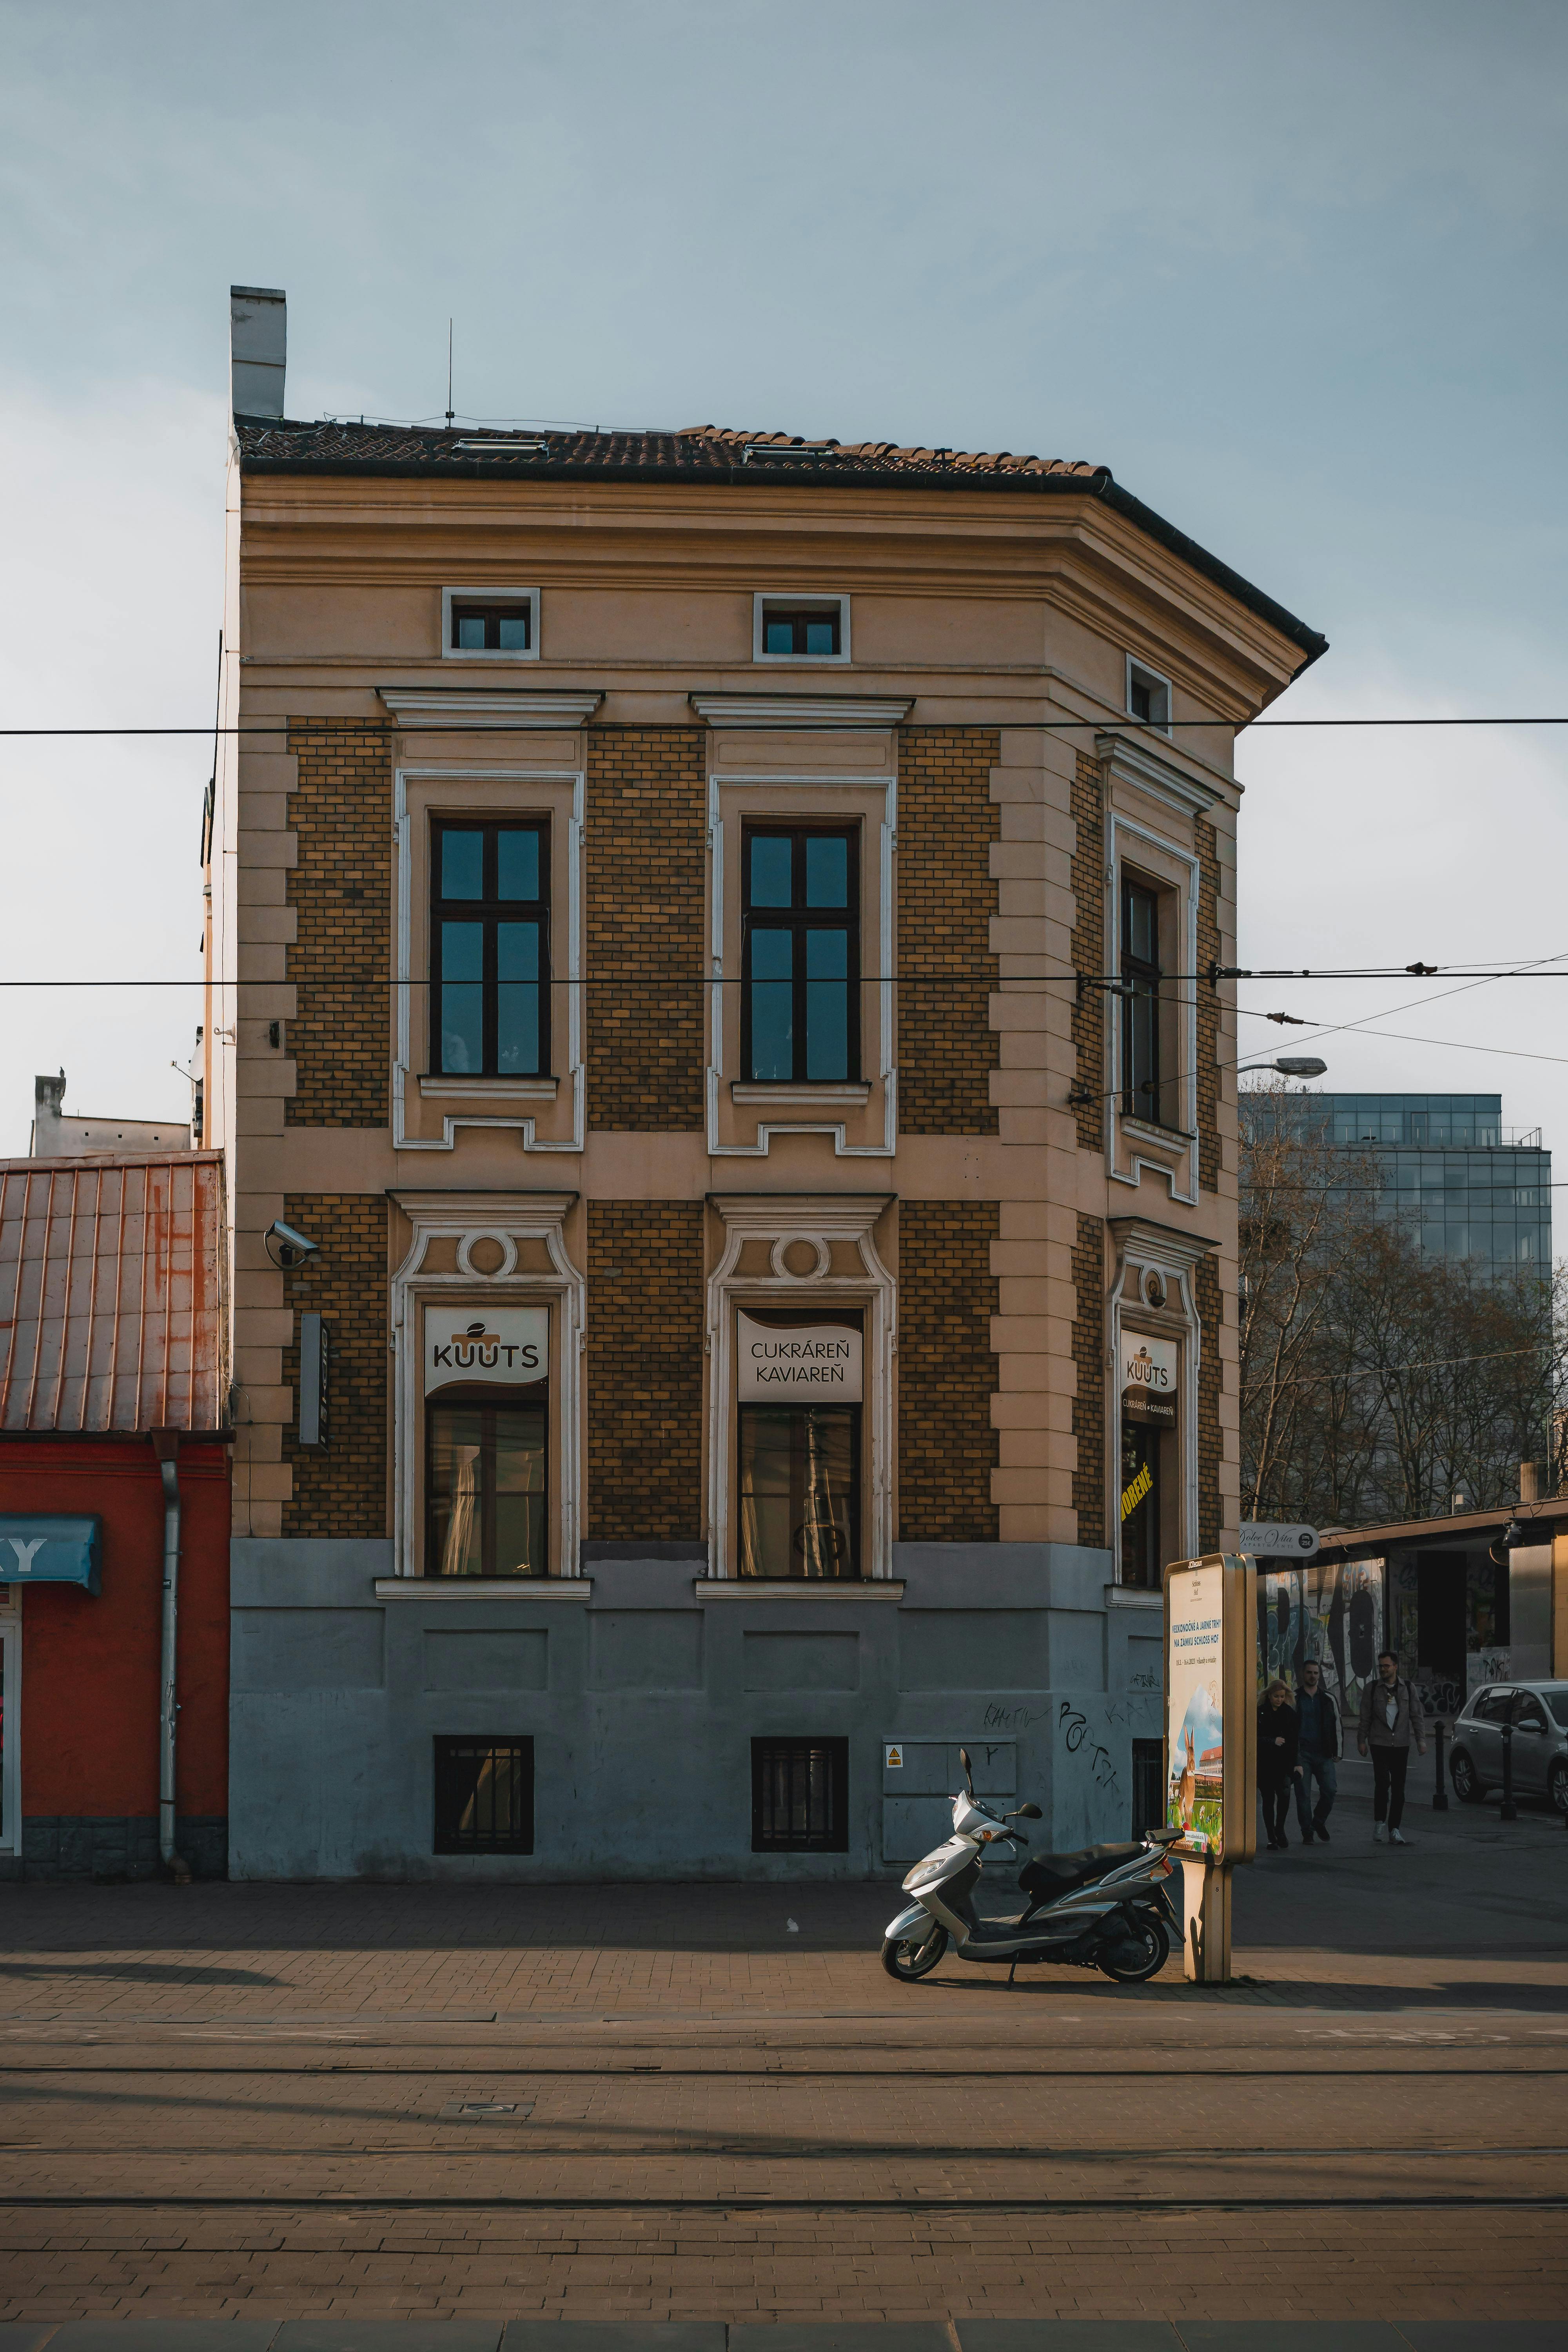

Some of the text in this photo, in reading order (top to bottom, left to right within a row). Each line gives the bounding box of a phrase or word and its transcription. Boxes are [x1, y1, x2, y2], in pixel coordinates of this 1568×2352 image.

[434, 1344, 539, 1368] KUUTS
[751, 1339, 849, 1359] CUKRÁREŇ
[756, 1363, 844, 1383] KAVIAREŇ
[1127, 1360, 1168, 1387] KUUTS
[1123, 1399, 1173, 1416] CUKRÁREŇ KAVIAREŇ
[1265, 1529, 1297, 1546] Vita
[0, 1538, 47, 1572] Y
[1196, 1622, 1200, 1631] A
[1200, 1617, 1211, 1630] JARNÉ
[1212, 1619, 1221, 1628] TRHY
[1174, 1634, 1219, 1648] NA ZÁMKU SCHLOSS HOF
